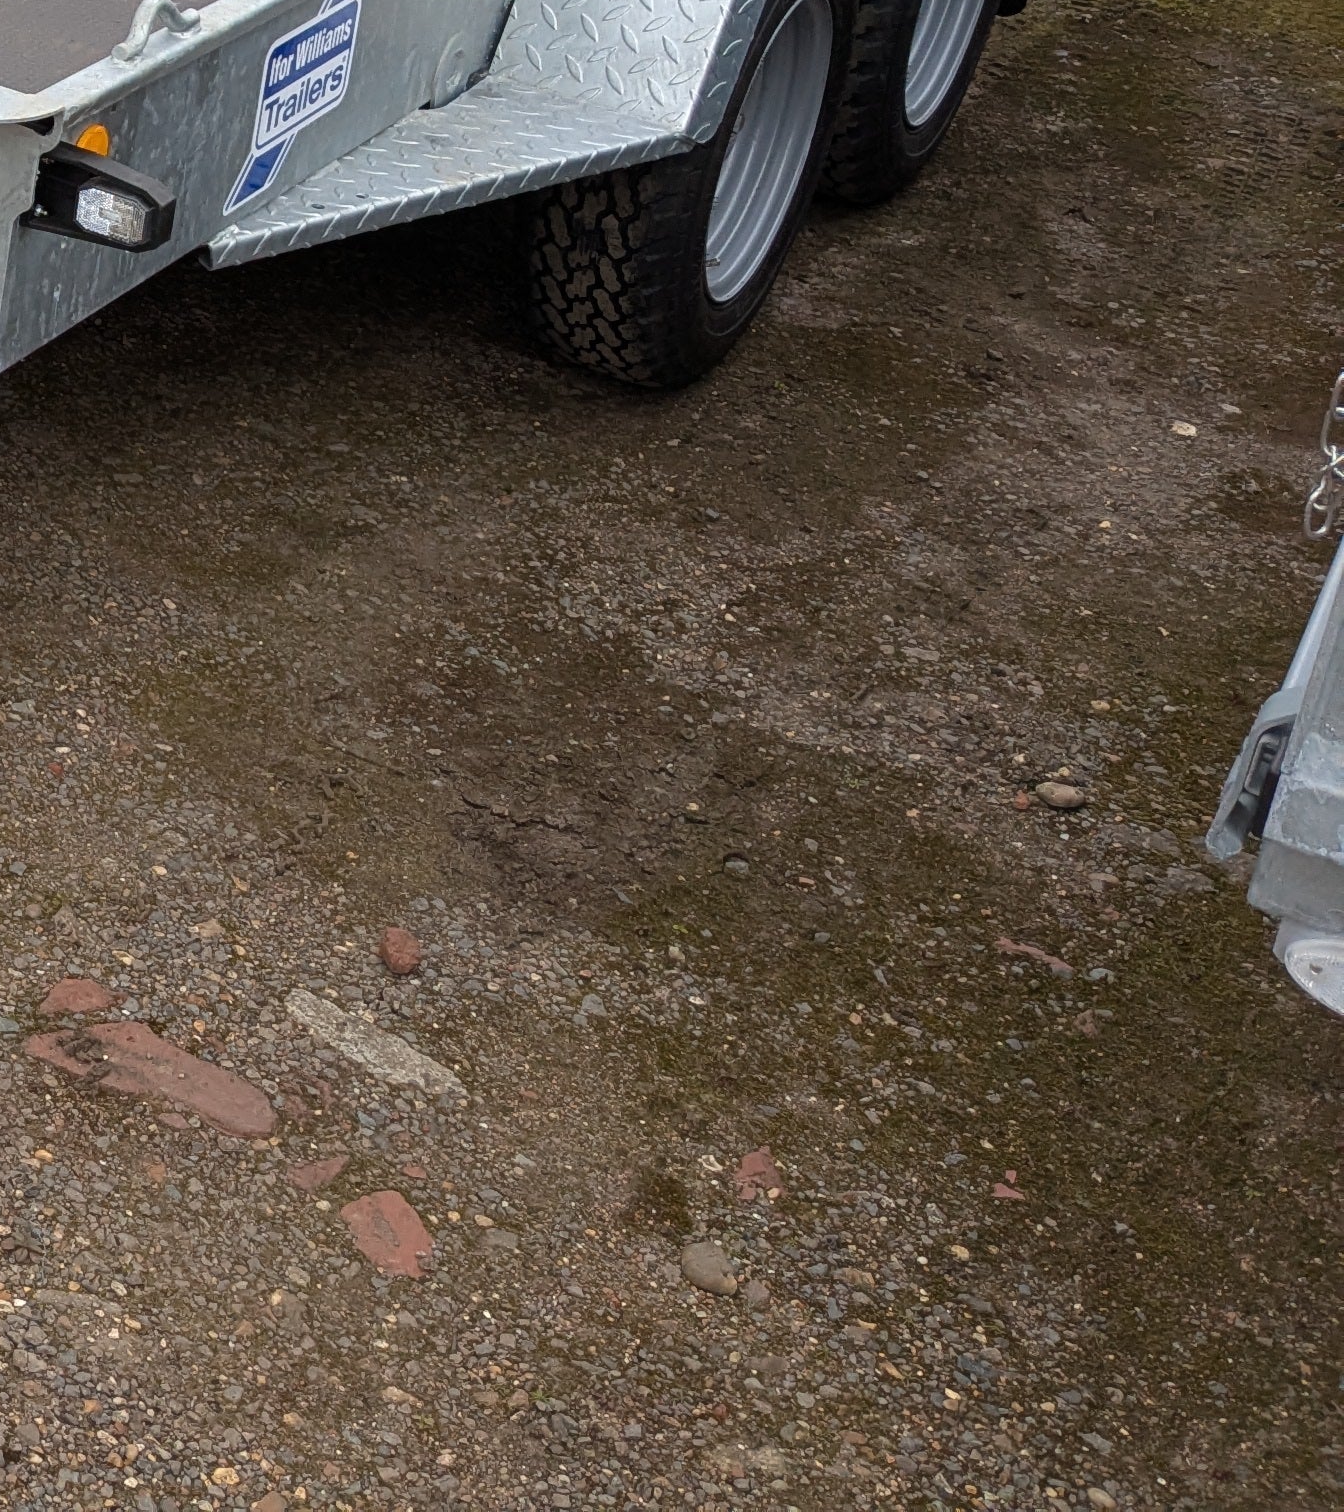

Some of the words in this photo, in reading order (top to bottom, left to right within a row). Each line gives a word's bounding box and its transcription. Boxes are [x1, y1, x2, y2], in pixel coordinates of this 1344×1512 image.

[268, 52, 294, 87] Ifor
[296, 18, 352, 70] Williams
[264, 64, 344, 133] Trailers
